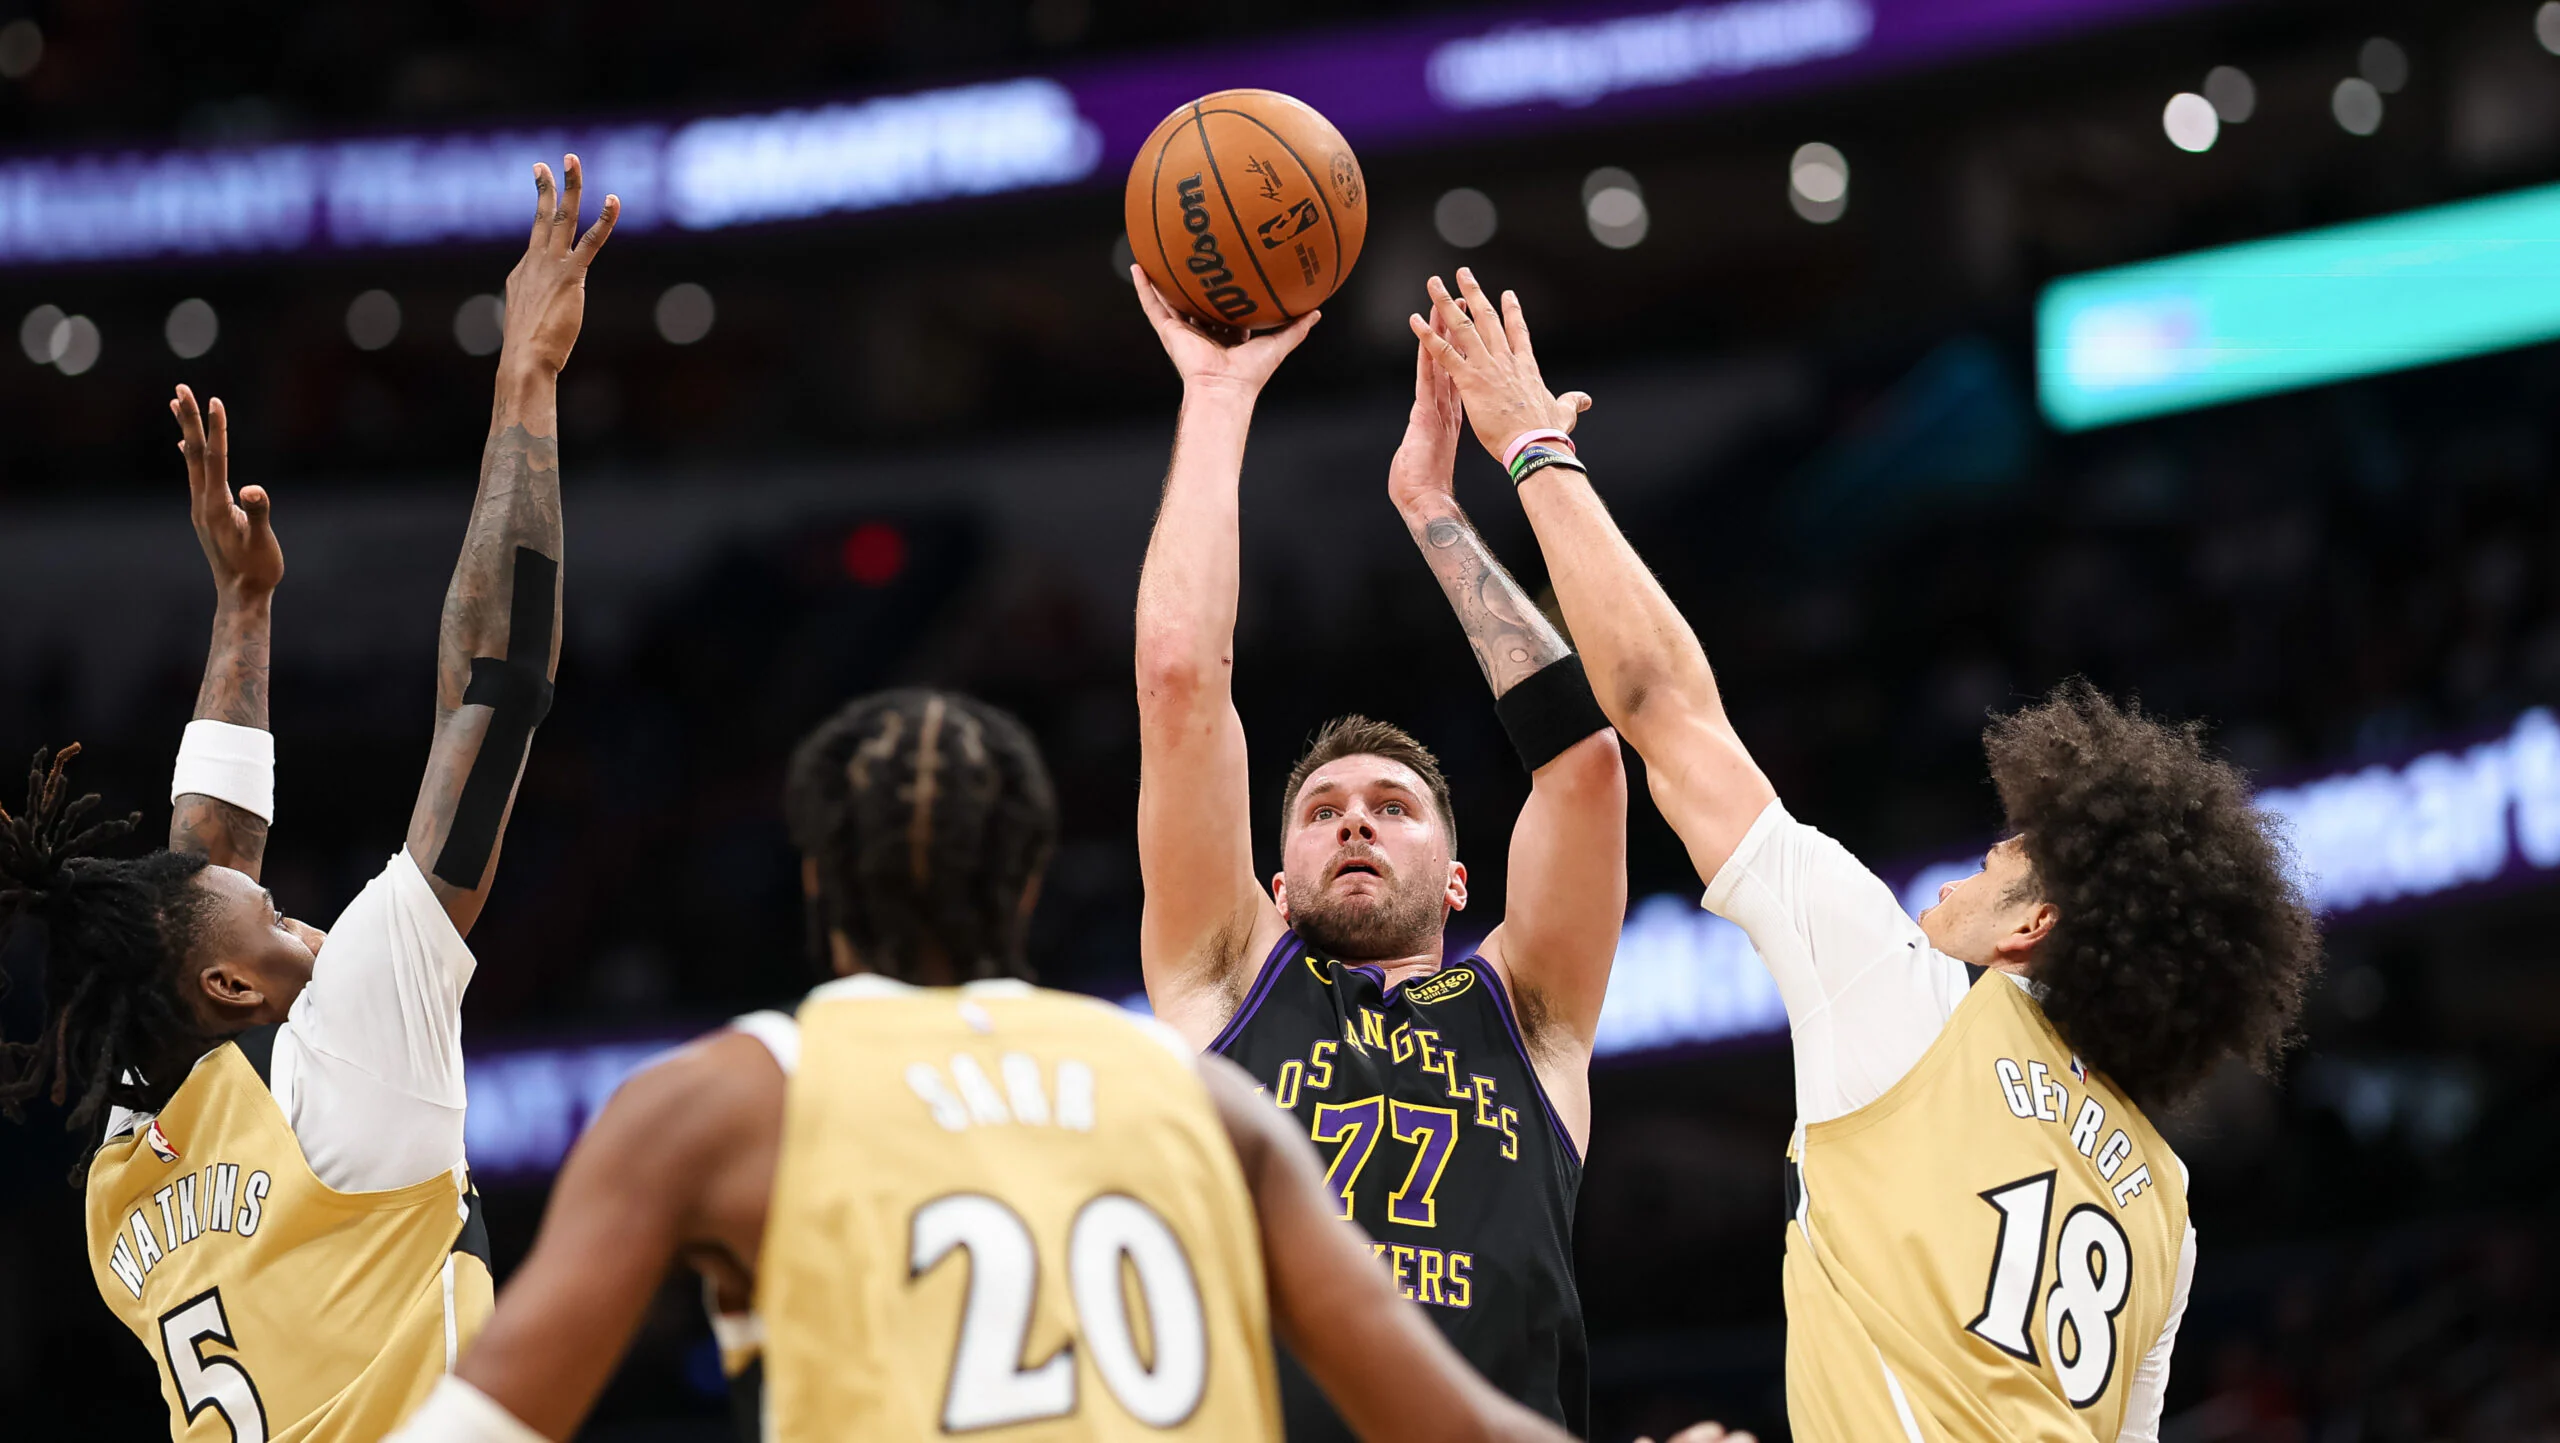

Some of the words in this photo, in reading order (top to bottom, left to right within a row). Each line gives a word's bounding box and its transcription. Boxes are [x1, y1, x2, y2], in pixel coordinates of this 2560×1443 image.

[1177, 172, 1258, 320] Wilson
[1409, 972, 1469, 1000] bibigo
[1252, 1039, 1340, 1110] OS
[1344, 1004, 1520, 1163] ANGELES
[1995, 1057, 2153, 1209] GEORGE
[109, 1162, 271, 1300] WATKINS
[1310, 1094, 1458, 1228] 77
[158, 1285, 269, 1443] 5
[904, 1191, 1212, 1433] 20
[1964, 1168, 2133, 1409] 18
